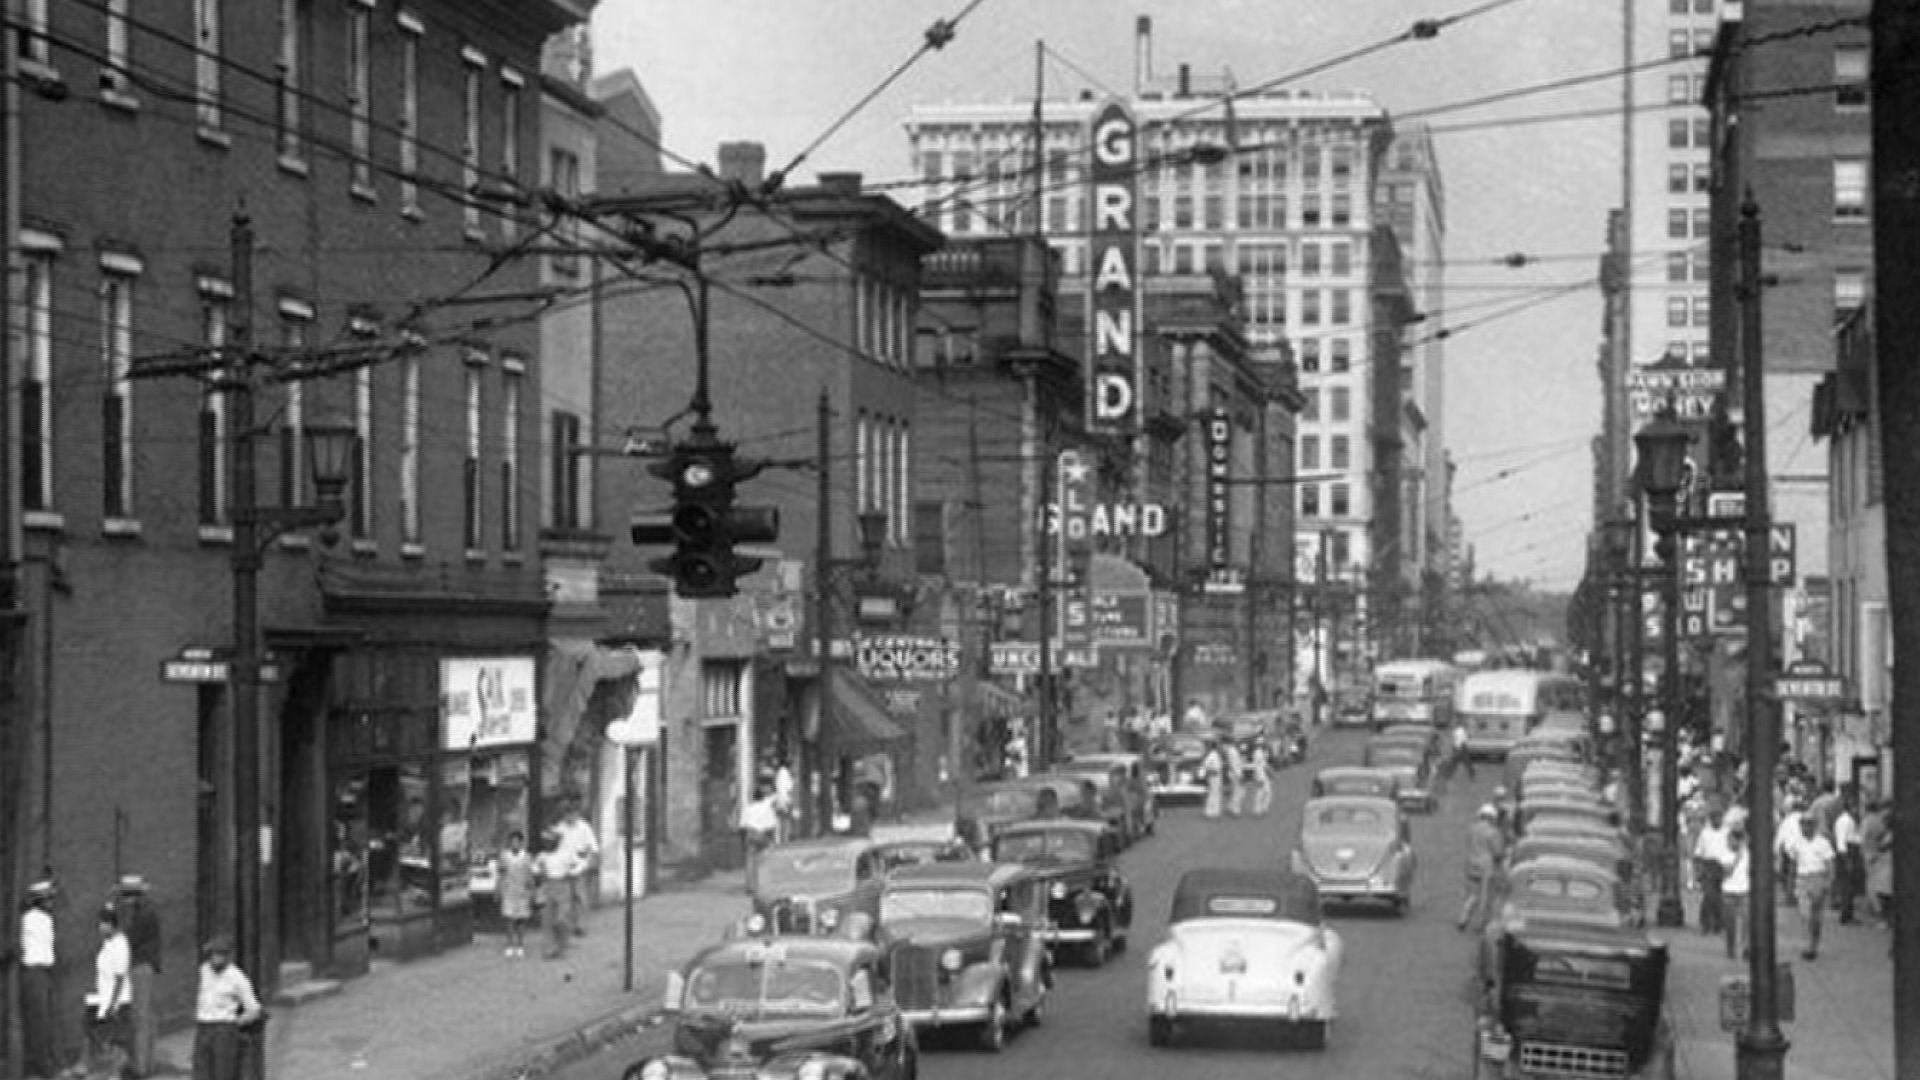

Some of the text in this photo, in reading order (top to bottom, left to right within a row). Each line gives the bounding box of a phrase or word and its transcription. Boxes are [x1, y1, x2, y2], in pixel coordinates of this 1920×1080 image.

[1096, 119, 1133, 418] GRAND
[1038, 502, 1165, 537] GAND
[1686, 557, 1791, 584] SHP
